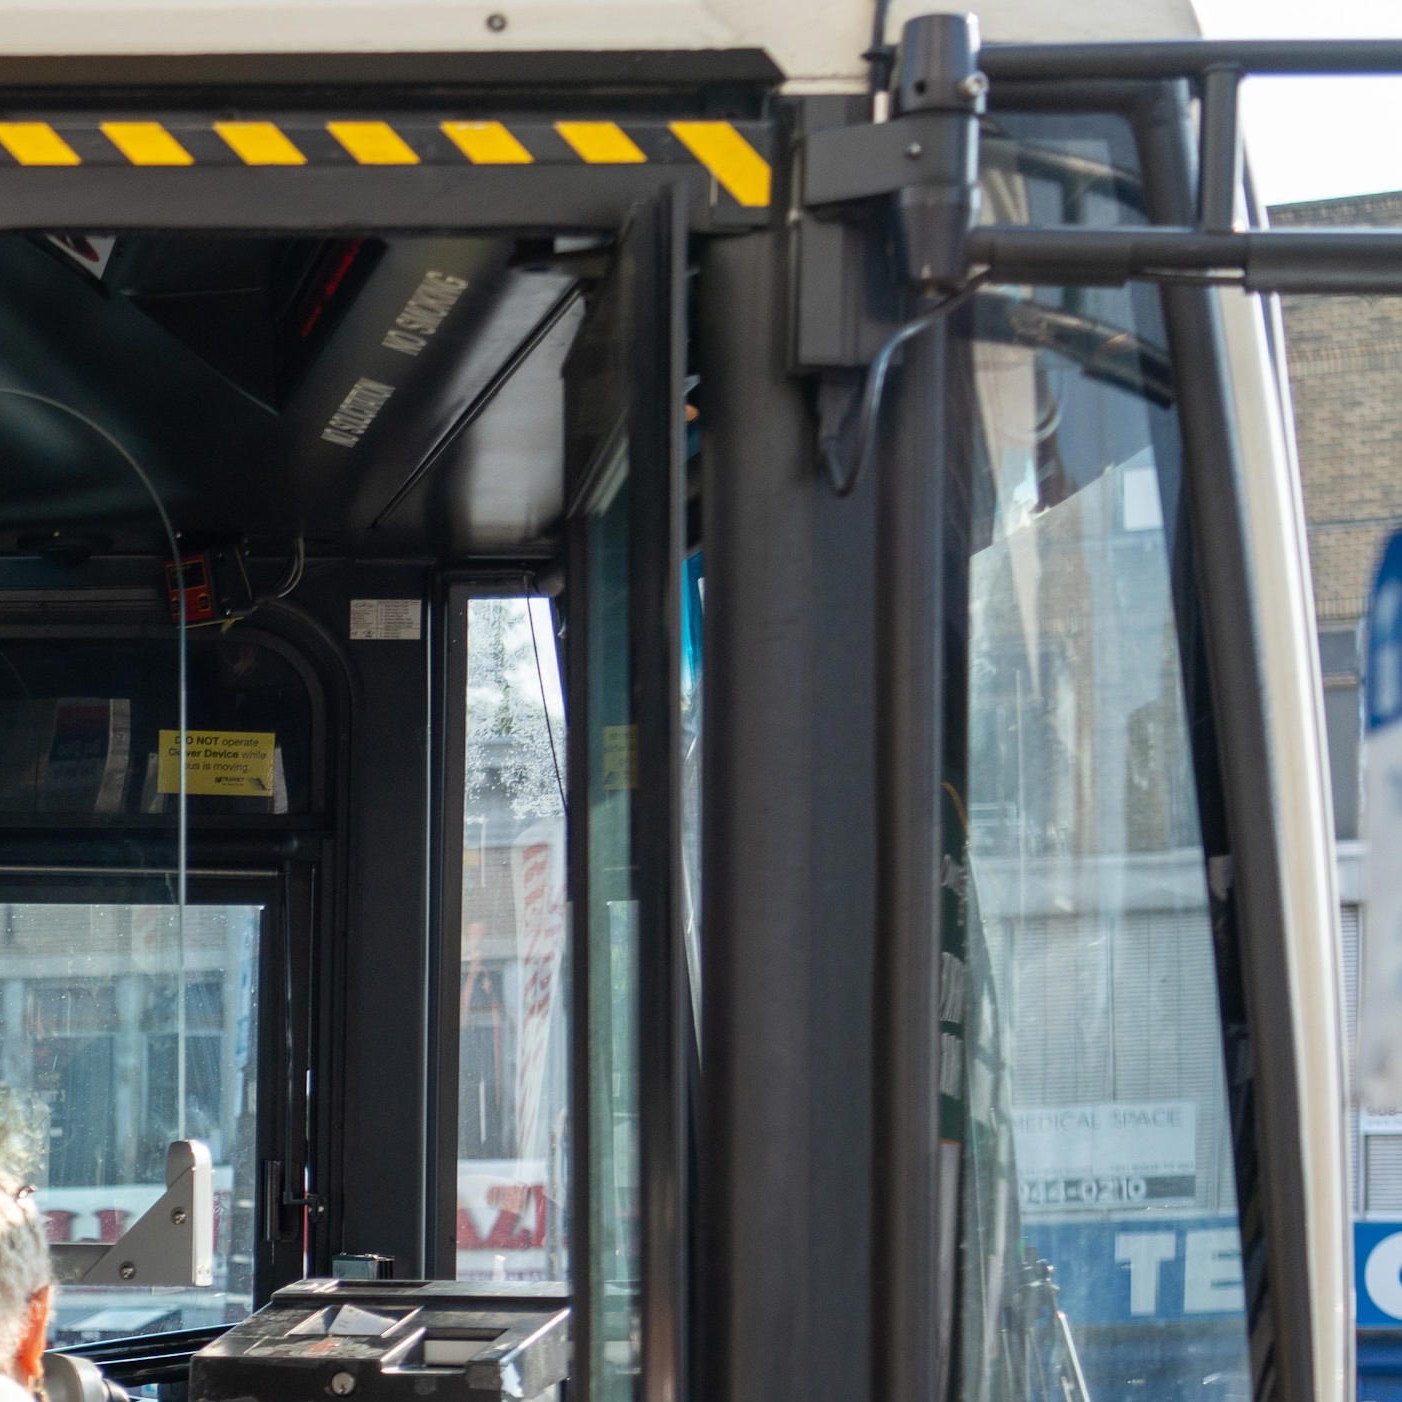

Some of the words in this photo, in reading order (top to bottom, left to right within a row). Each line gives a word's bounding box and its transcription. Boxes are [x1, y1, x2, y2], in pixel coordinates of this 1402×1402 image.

[196, 736, 219, 745] NOT
[222, 738, 259, 747] operate
[204, 749, 239, 758] Device
